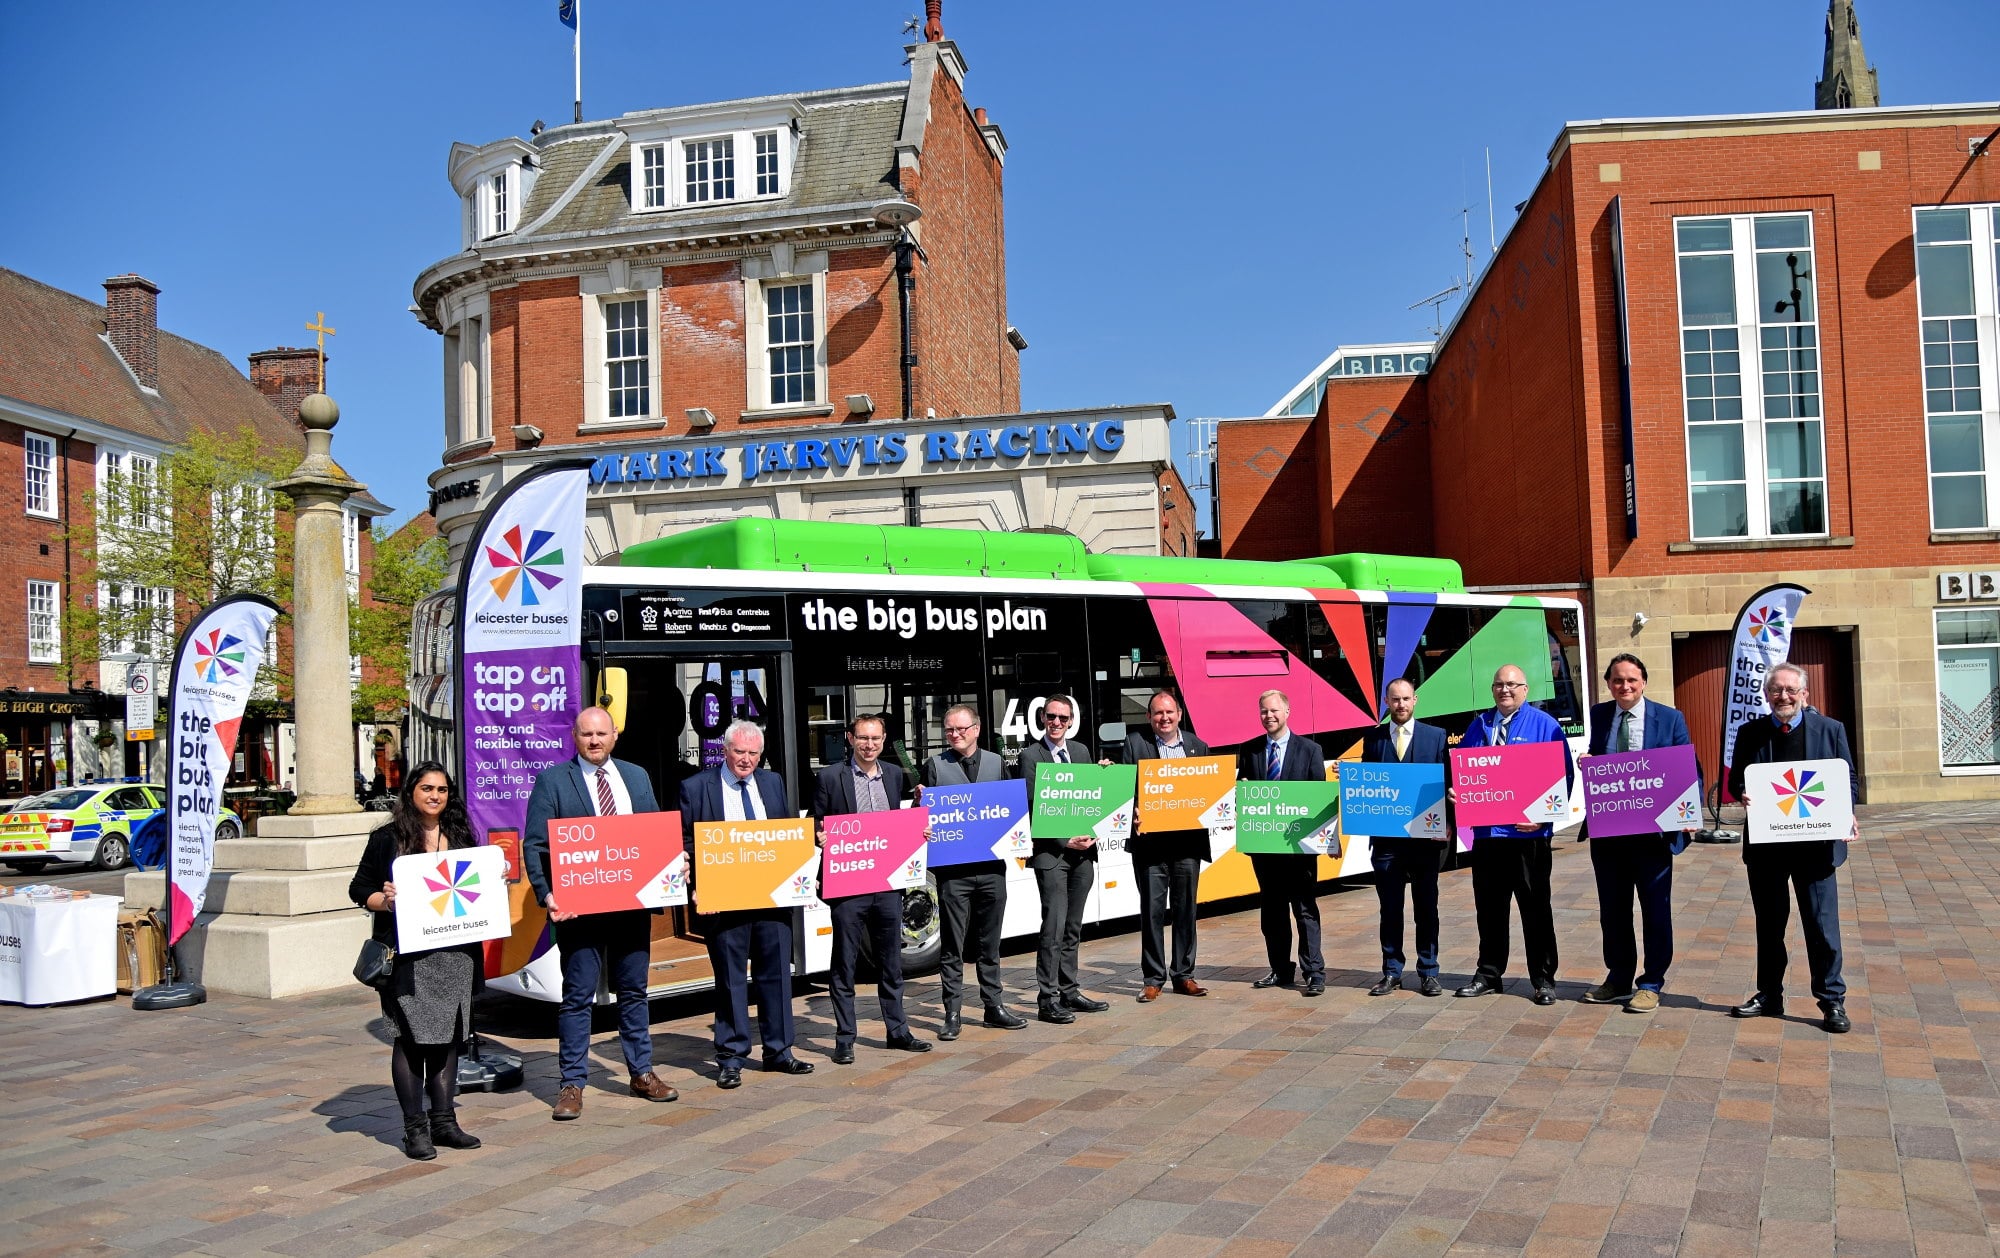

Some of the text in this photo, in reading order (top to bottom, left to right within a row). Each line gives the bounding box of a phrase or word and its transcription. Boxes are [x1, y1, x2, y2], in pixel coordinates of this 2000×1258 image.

[1351, 357, 1426, 376] BBC
[589, 419, 1125, 485] MARK JARVIS RACING
[475, 612, 568, 624] leicester buses
[737, 608, 770, 616] Centrebus
[801, 598, 1047, 639] the big bus plan
[665, 623, 692, 631] Roberts
[699, 623, 727, 631] Kinchbus
[846, 655, 943, 671] leicester buses
[1737, 657, 1766, 674] the
[474, 661, 565, 690] tap on
[1734, 673, 1763, 692] big
[209, 688, 236, 701] buses
[474, 686, 567, 717] tap off
[1733, 689, 1763, 707] bus
[12, 702, 45, 713] HIGH
[181, 709, 211, 734] the
[474, 723, 534, 736] easy and
[1567, 724, 1584, 734] value
[180, 736, 207, 766] big
[475, 738, 562, 749] flexible travel
[476, 758, 555, 772] you'll always
[1457, 754, 1501, 768] 1 new
[1587, 757, 1651, 774] network
[179, 762, 210, 788] bus
[1041, 769, 1074, 783] 4 on
[1144, 763, 1218, 778] 4 discount
[1344, 768, 1390, 782] 12 bus
[476, 775, 498, 787] get
[502, 774, 524, 785] the
[1144, 782, 1174, 794] fare
[1458, 773, 1488, 787] bus
[1586, 773, 1666, 796] 'best fare'
[476, 788, 532, 800] value far
[925, 792, 972, 808] 3 new
[1040, 786, 1102, 800] demand
[1242, 786, 1281, 801] 1,000
[1345, 784, 1400, 801] priority
[1459, 787, 1515, 804] station
[178, 789, 214, 817] plan
[1039, 802, 1102, 817] flexi lines
[1144, 797, 1206, 812] schemes
[1242, 803, 1309, 816] real time
[1345, 801, 1412, 816] schemes
[1591, 795, 1654, 816] promise
[930, 805, 1010, 827] park & ride
[557, 824, 595, 844] 500
[830, 819, 861, 836] 400
[1242, 819, 1301, 834] displays
[702, 826, 804, 845] 30 frequent
[930, 827, 964, 843] sites
[830, 837, 888, 855] electric
[178, 858, 192, 866] easy
[559, 845, 640, 865] new bus
[702, 847, 776, 865] bus lines
[830, 857, 875, 874] buses
[560, 867, 633, 887] shelters
[422, 920, 489, 935] leicester buses
